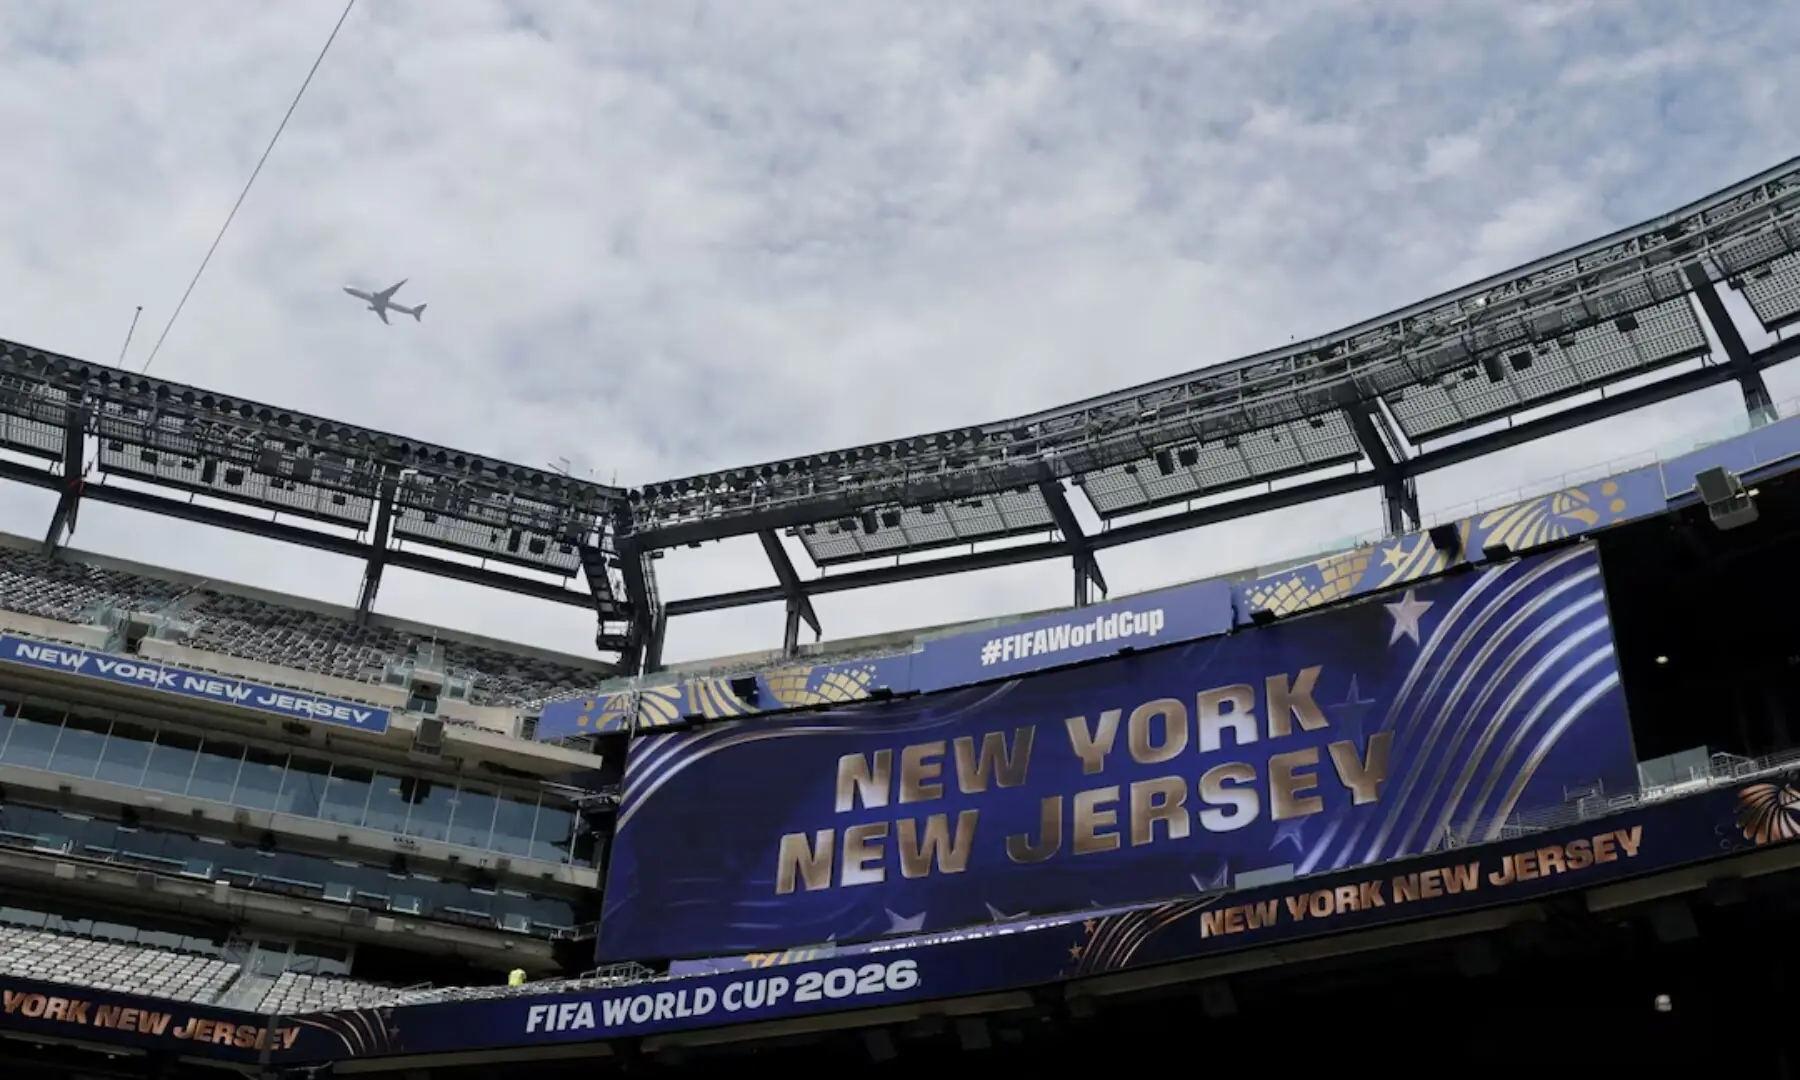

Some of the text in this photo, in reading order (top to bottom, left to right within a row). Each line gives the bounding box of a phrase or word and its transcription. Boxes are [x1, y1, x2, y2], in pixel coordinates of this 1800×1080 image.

[981, 609, 1164, 665] #FIFAWorldCup
[15, 643, 372, 723] NEW YORK NEW JERSEY
[835, 666, 1328, 814] NEW YORK
[775, 733, 1393, 895] NEW JERSEY
[1200, 826, 1642, 938] NEW YORK NEW JERSEY
[3, 990, 91, 1024] YORK
[94, 1005, 171, 1036] NEW
[526, 959, 918, 1034] FIFA WORLD CUP 2026
